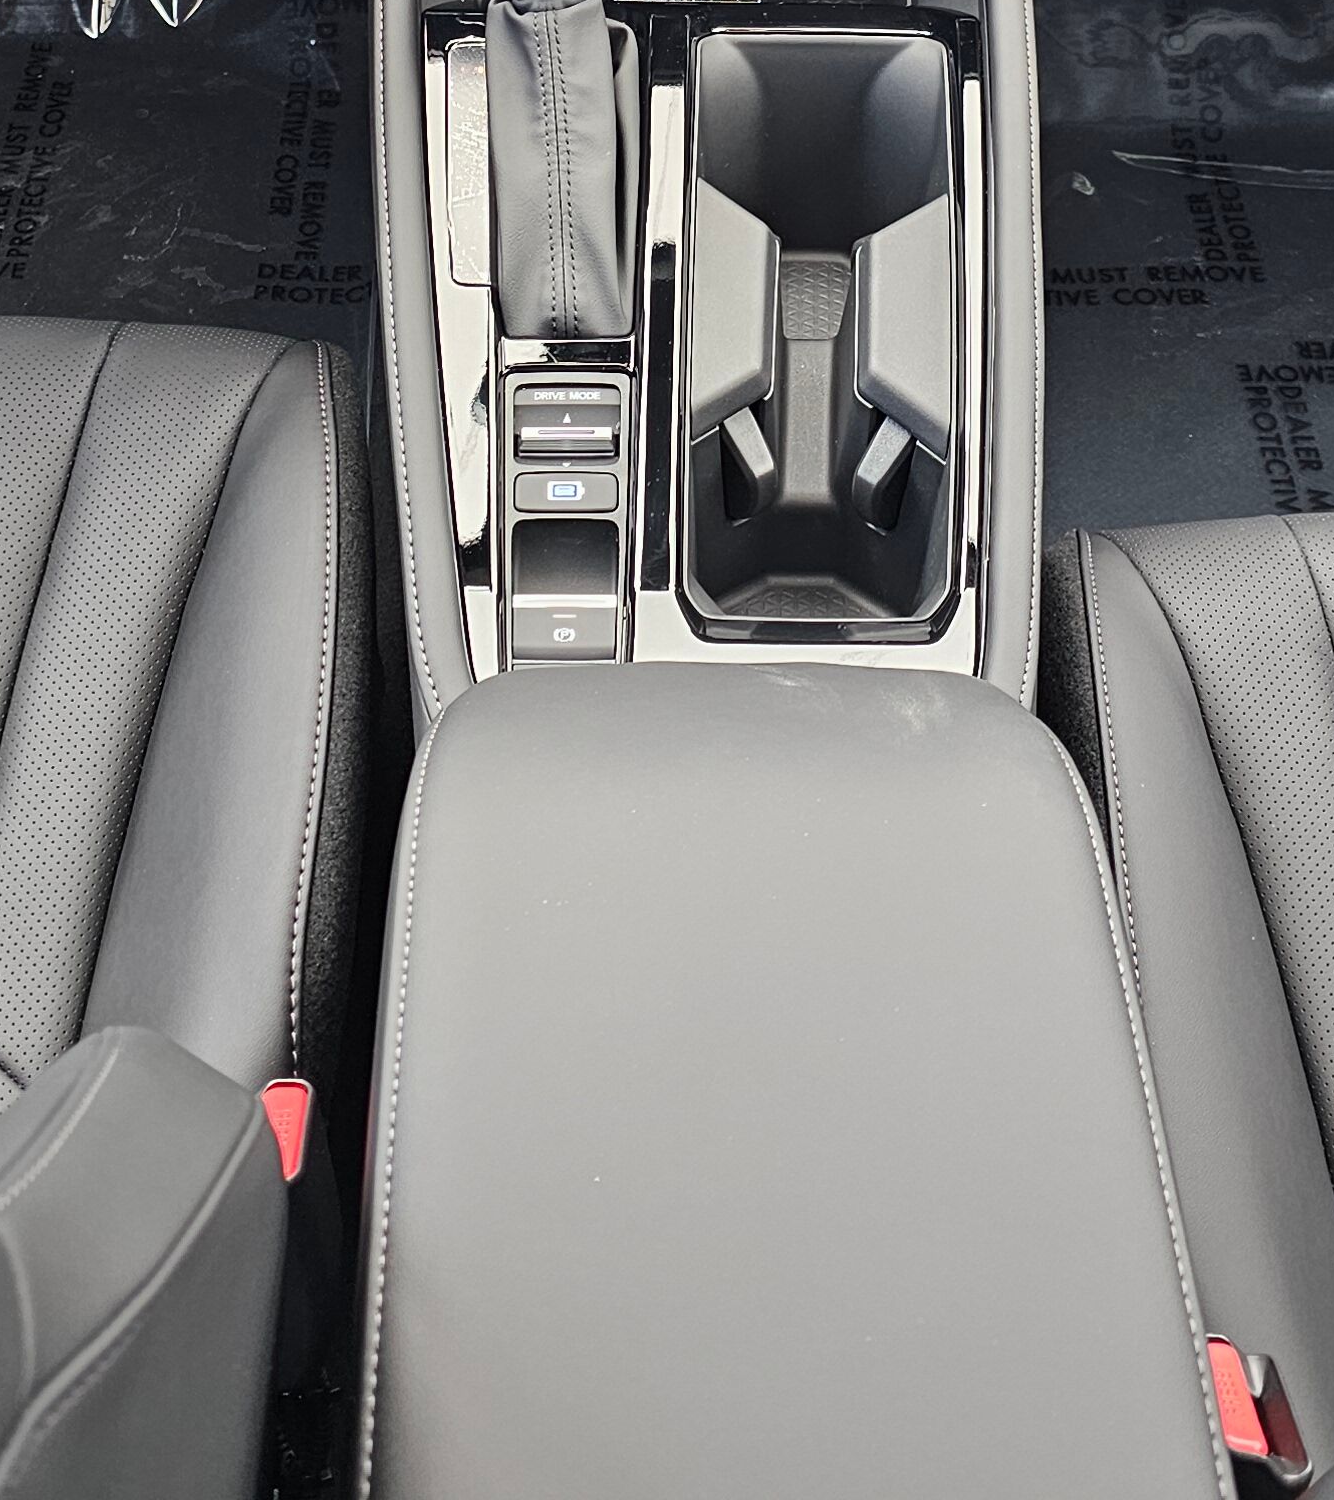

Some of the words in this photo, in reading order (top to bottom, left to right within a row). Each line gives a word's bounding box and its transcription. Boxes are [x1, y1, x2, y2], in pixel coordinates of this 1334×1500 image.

[13, 42, 53, 112] REMOVE
[6, 146, 51, 258] PROTECTIVE
[39, 81, 74, 138] COVER
[308, 119, 336, 171] MUST
[269, 153, 299, 218] COVER
[294, 181, 326, 261] REMOVE
[257, 263, 364, 282] DEALER
[1049, 266, 1129, 284] MUST
[1146, 265, 1267, 283] REMOVE
[1112, 287, 1211, 306] COVER
[533, 391, 567, 401] DRIVE
[569, 391, 601, 400] MODE
[1278, 386, 1323, 472] DEALER
